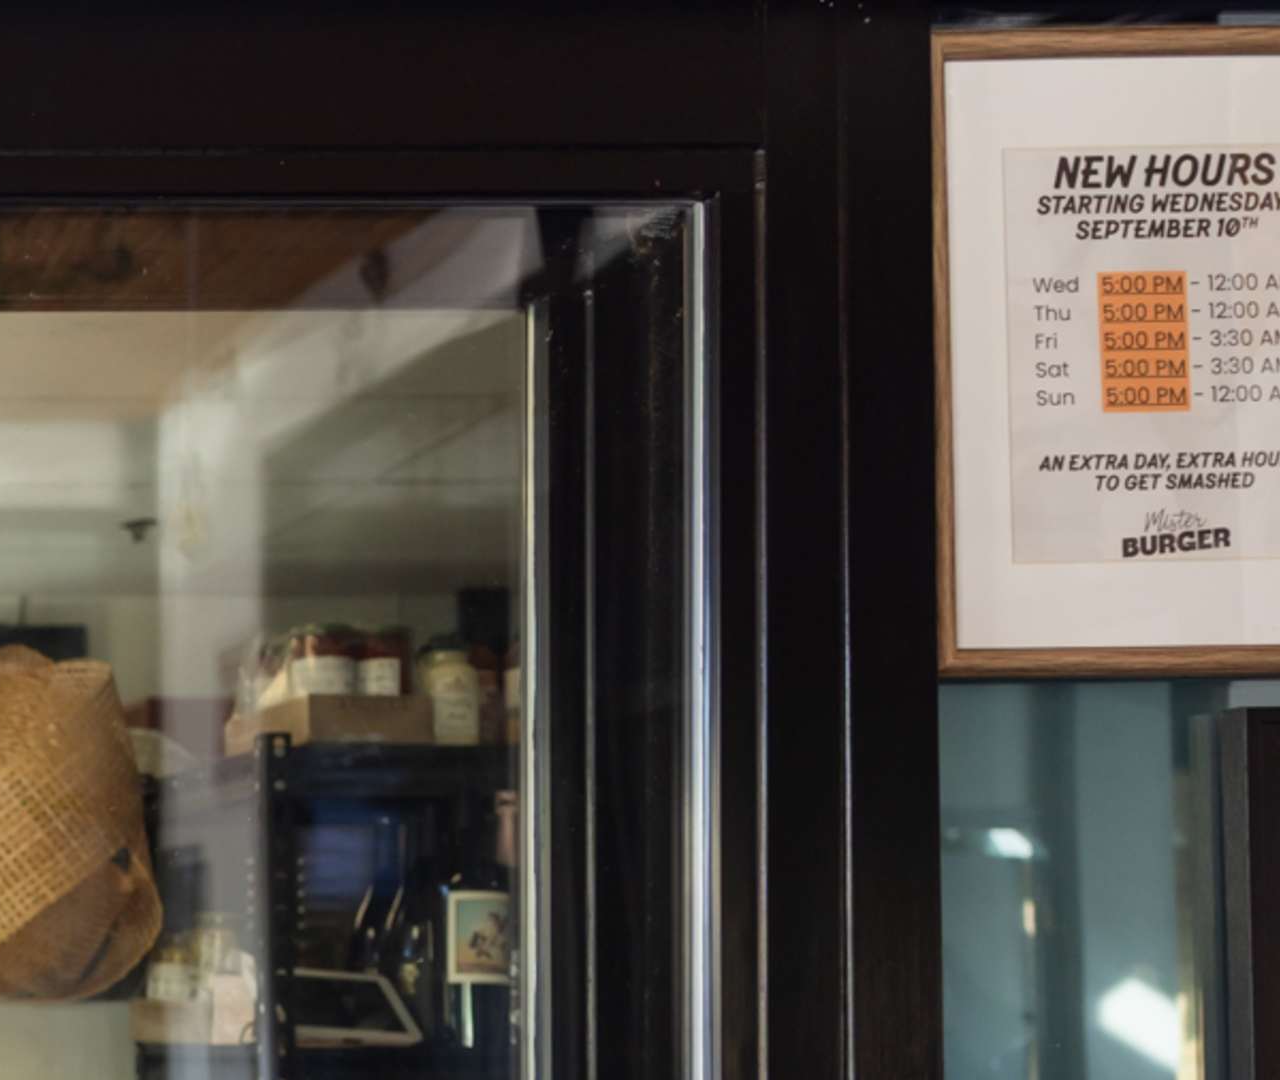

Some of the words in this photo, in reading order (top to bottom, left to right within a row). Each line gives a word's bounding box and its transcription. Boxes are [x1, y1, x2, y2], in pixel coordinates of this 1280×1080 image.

[1053, 155, 1137, 189] NEW
[1144, 153, 1276, 187] HOURS
[1037, 194, 1145, 215] STARTING
[1075, 219, 1211, 240] SEPTEMBER
[1033, 276, 1079, 293] Wed
[1102, 275, 1147, 293] 5:00
[1153, 274, 1184, 292] PM
[1208, 273, 1258, 291] 12:00
[1265, 274, 1279, 290] A
[1034, 304, 1071, 321] Thu
[1103, 303, 1148, 321] 5:00
[1154, 302, 1185, 320] PM
[1209, 301, 1259, 319] 12:00
[1266, 302, 1280, 318] A
[1035, 332, 1058, 349] Fri
[1104, 331, 1148, 349] 5:00
[1154, 330, 1186, 348] PM
[1210, 329, 1253, 347] 3:30
[1035, 361, 1070, 378] Sat
[1105, 359, 1150, 377] 5:00
[1155, 358, 1186, 376] PM
[1211, 357, 1254, 375] 3:30
[1261, 357, 1280, 374] A
[1035, 389, 1075, 406] Sun
[1106, 387, 1150, 404] 5:00
[1156, 386, 1187, 404] PM
[1211, 385, 1262, 402] 12:00
[1270, 385, 1280, 401] A
[1039, 455, 1064, 472] AN
[1068, 454, 1128, 471] EXTRA
[1133, 453, 1171, 471] DAY,
[1176, 452, 1236, 469] EXTRA
[1241, 451, 1280, 468] HOU
[1095, 475, 1119, 492] TO
[1125, 473, 1161, 491] GET
[1165, 471, 1255, 490] SMASHED
[1144, 508, 1207, 533] Mister
[1122, 527, 1231, 558] BURGER
